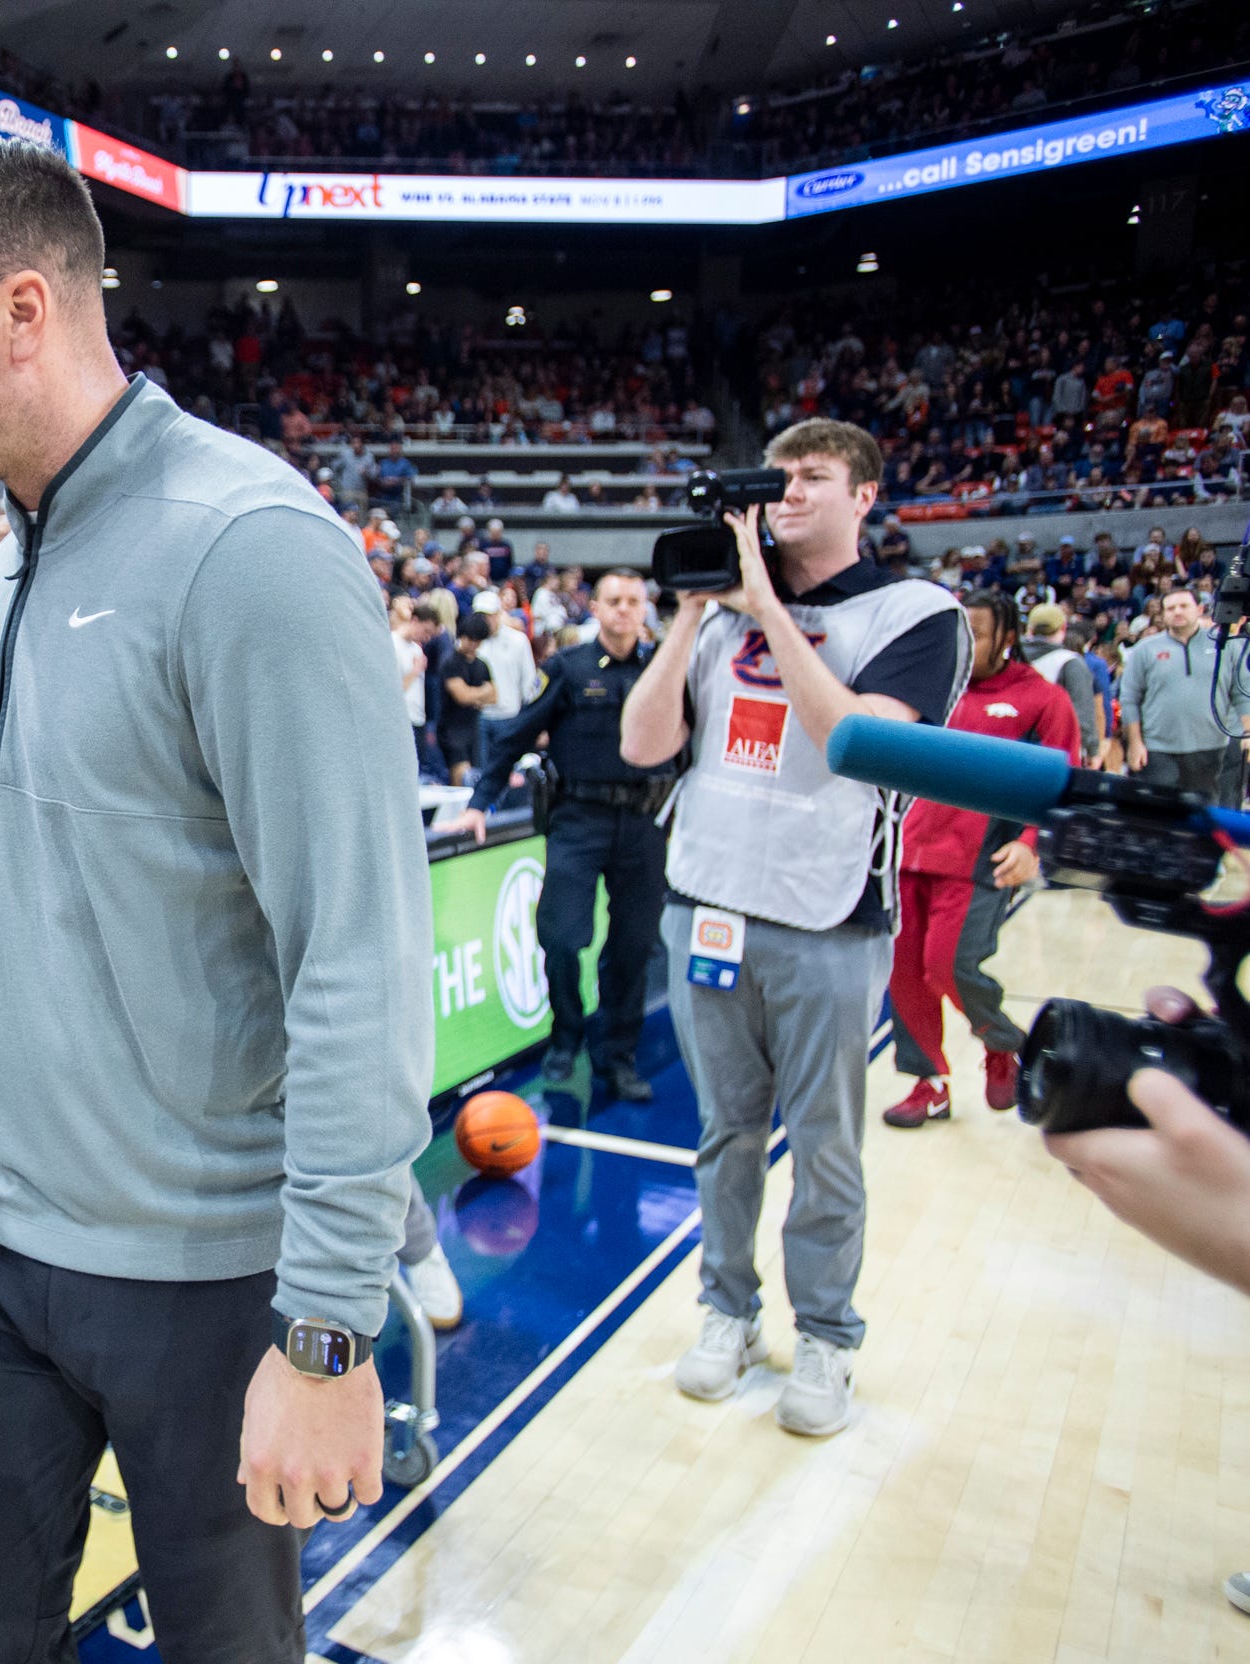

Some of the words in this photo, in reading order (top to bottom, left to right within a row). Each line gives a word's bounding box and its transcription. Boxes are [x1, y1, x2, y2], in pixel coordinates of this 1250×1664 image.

[965, 117, 1148, 176] Sensigreen!
[730, 737, 778, 761] ALFA
[433, 938, 487, 1019] HE
